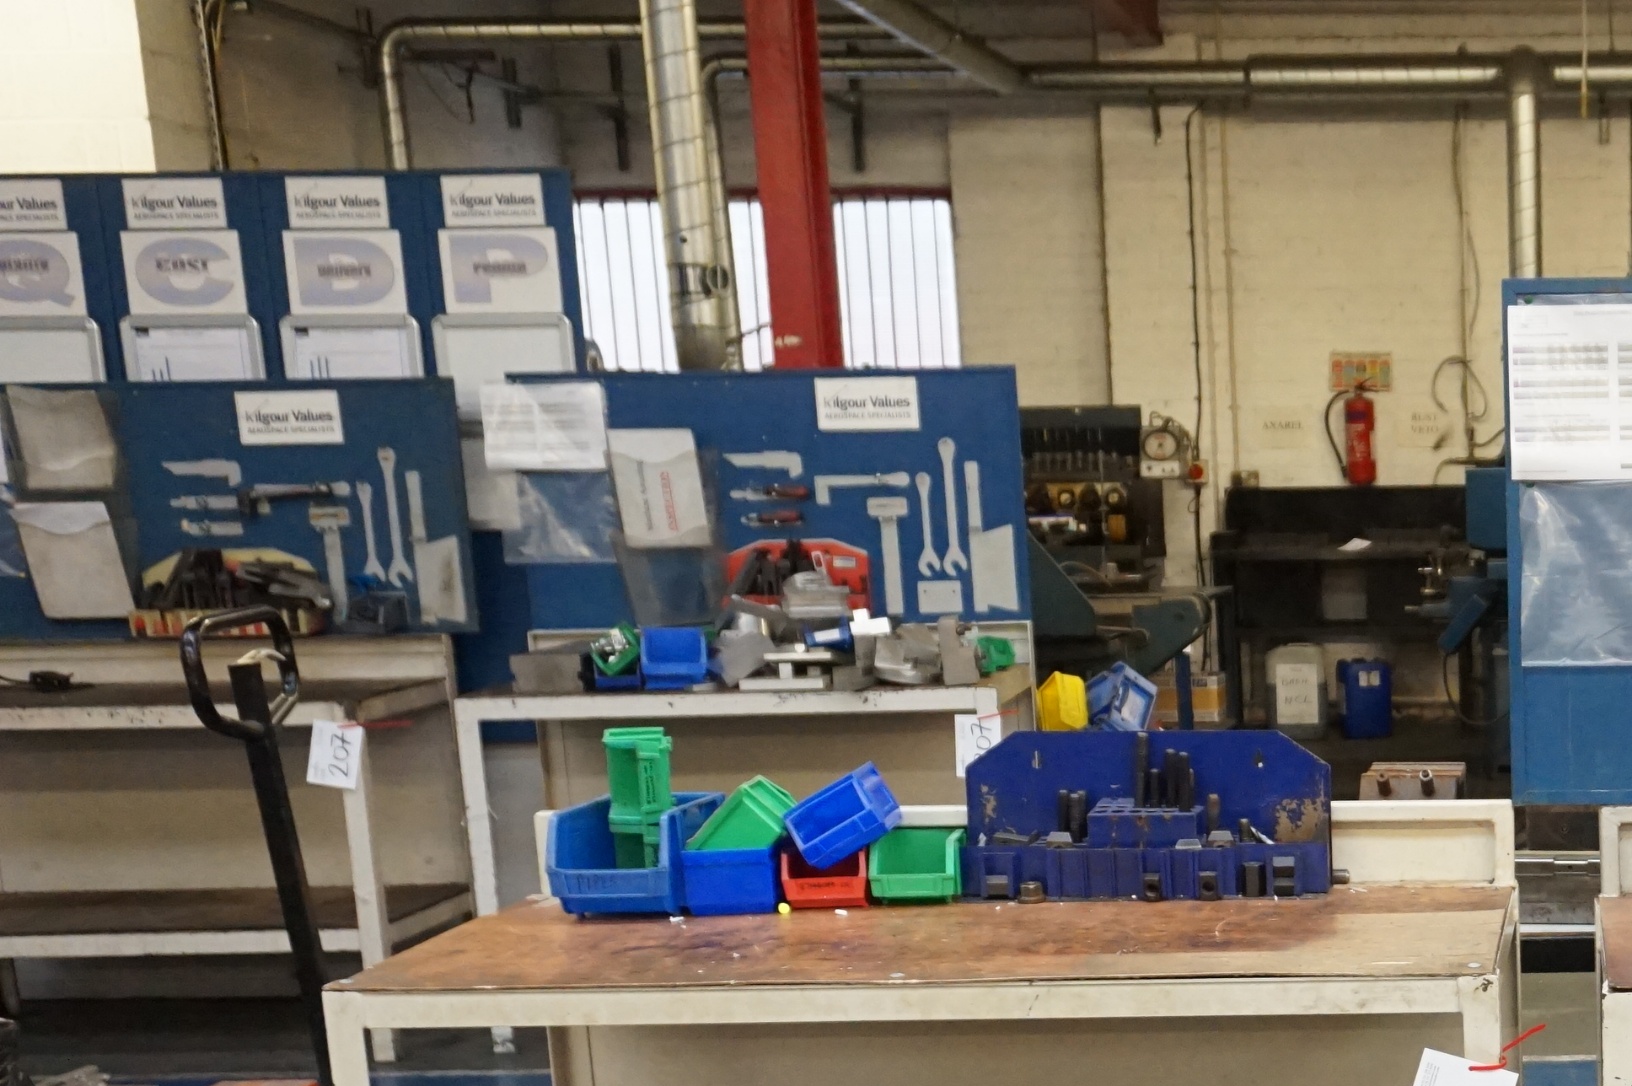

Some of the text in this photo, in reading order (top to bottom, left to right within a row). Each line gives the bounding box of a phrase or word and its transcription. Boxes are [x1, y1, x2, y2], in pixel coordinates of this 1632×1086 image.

[822, 395, 910, 410] Kilgour Values
[291, 409, 333, 421] Values
[328, 731, 351, 777] 207
